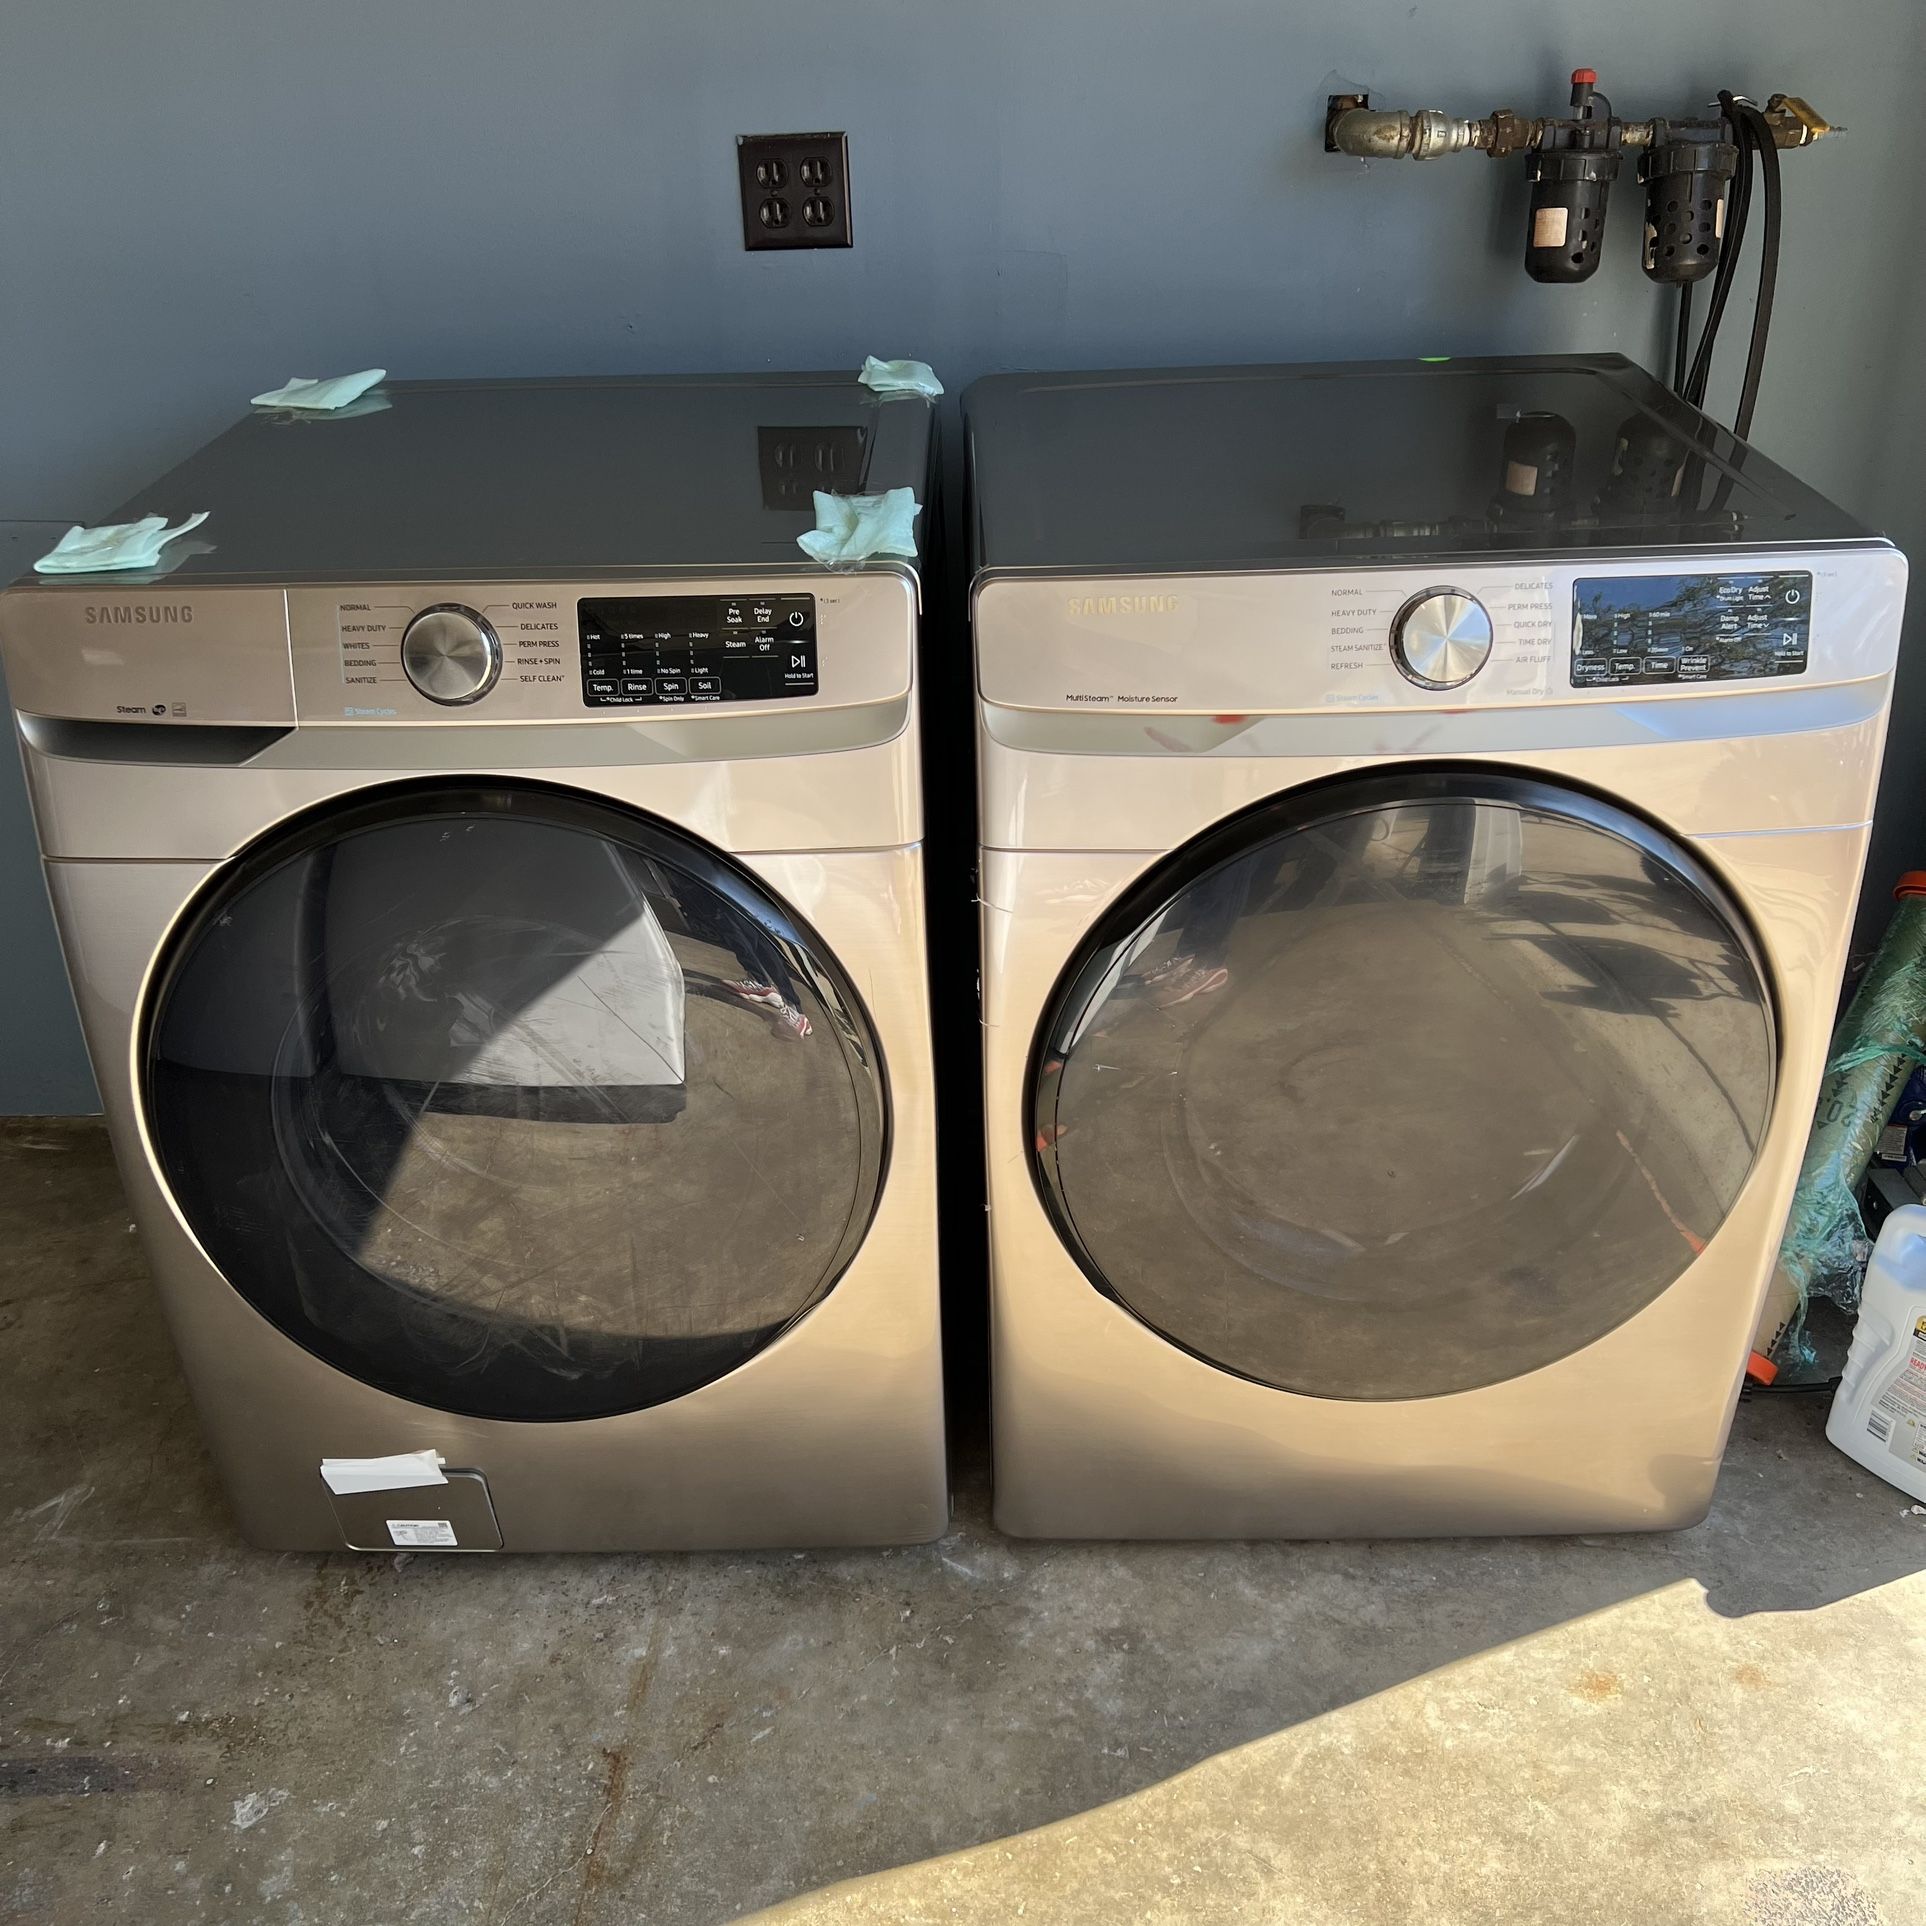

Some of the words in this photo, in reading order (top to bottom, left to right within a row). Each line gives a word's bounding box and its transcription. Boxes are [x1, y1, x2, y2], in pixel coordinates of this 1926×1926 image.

[1515, 582, 1553, 590] DELICATES
[512, 602, 534, 610] QUICK
[1067, 595, 1179, 616] SAMSUNG
[85, 606, 193, 624] SAMSUNG
[754, 607, 772, 616] Delay
[1331, 609, 1356, 617] HEAVY
[1357, 608, 1377, 616] DUTY
[757, 615, 769, 623] End
[1747, 614, 1768, 622] Adjust
[367, 624, 386, 632] DUTY
[1514, 621, 1536, 629] QUICK
[1331, 627, 1363, 635] BEDDING
[658, 632, 671, 640] High
[519, 640, 537, 648] PERM
[538, 640, 560, 648] PRESS
[344, 659, 377, 667] BEDDING
[1680, 656, 1707, 664] Wrinkle
[1330, 662, 1363, 670] REFRESH
[1576, 664, 1605, 673] Dryness
[1614, 663, 1635, 671] Temp.
[1651, 661, 1669, 669] Time
[668, 667, 681, 675] Spin
[592, 684, 614, 692] Temp.
[627, 683, 647, 691] Rinse
[663, 682, 679, 692] Spin
[698, 681, 711, 690] Soil
[1117, 695, 1150, 703] Moisture
[1151, 695, 1178, 703] Sensor
[116, 705, 146, 714] Steam
